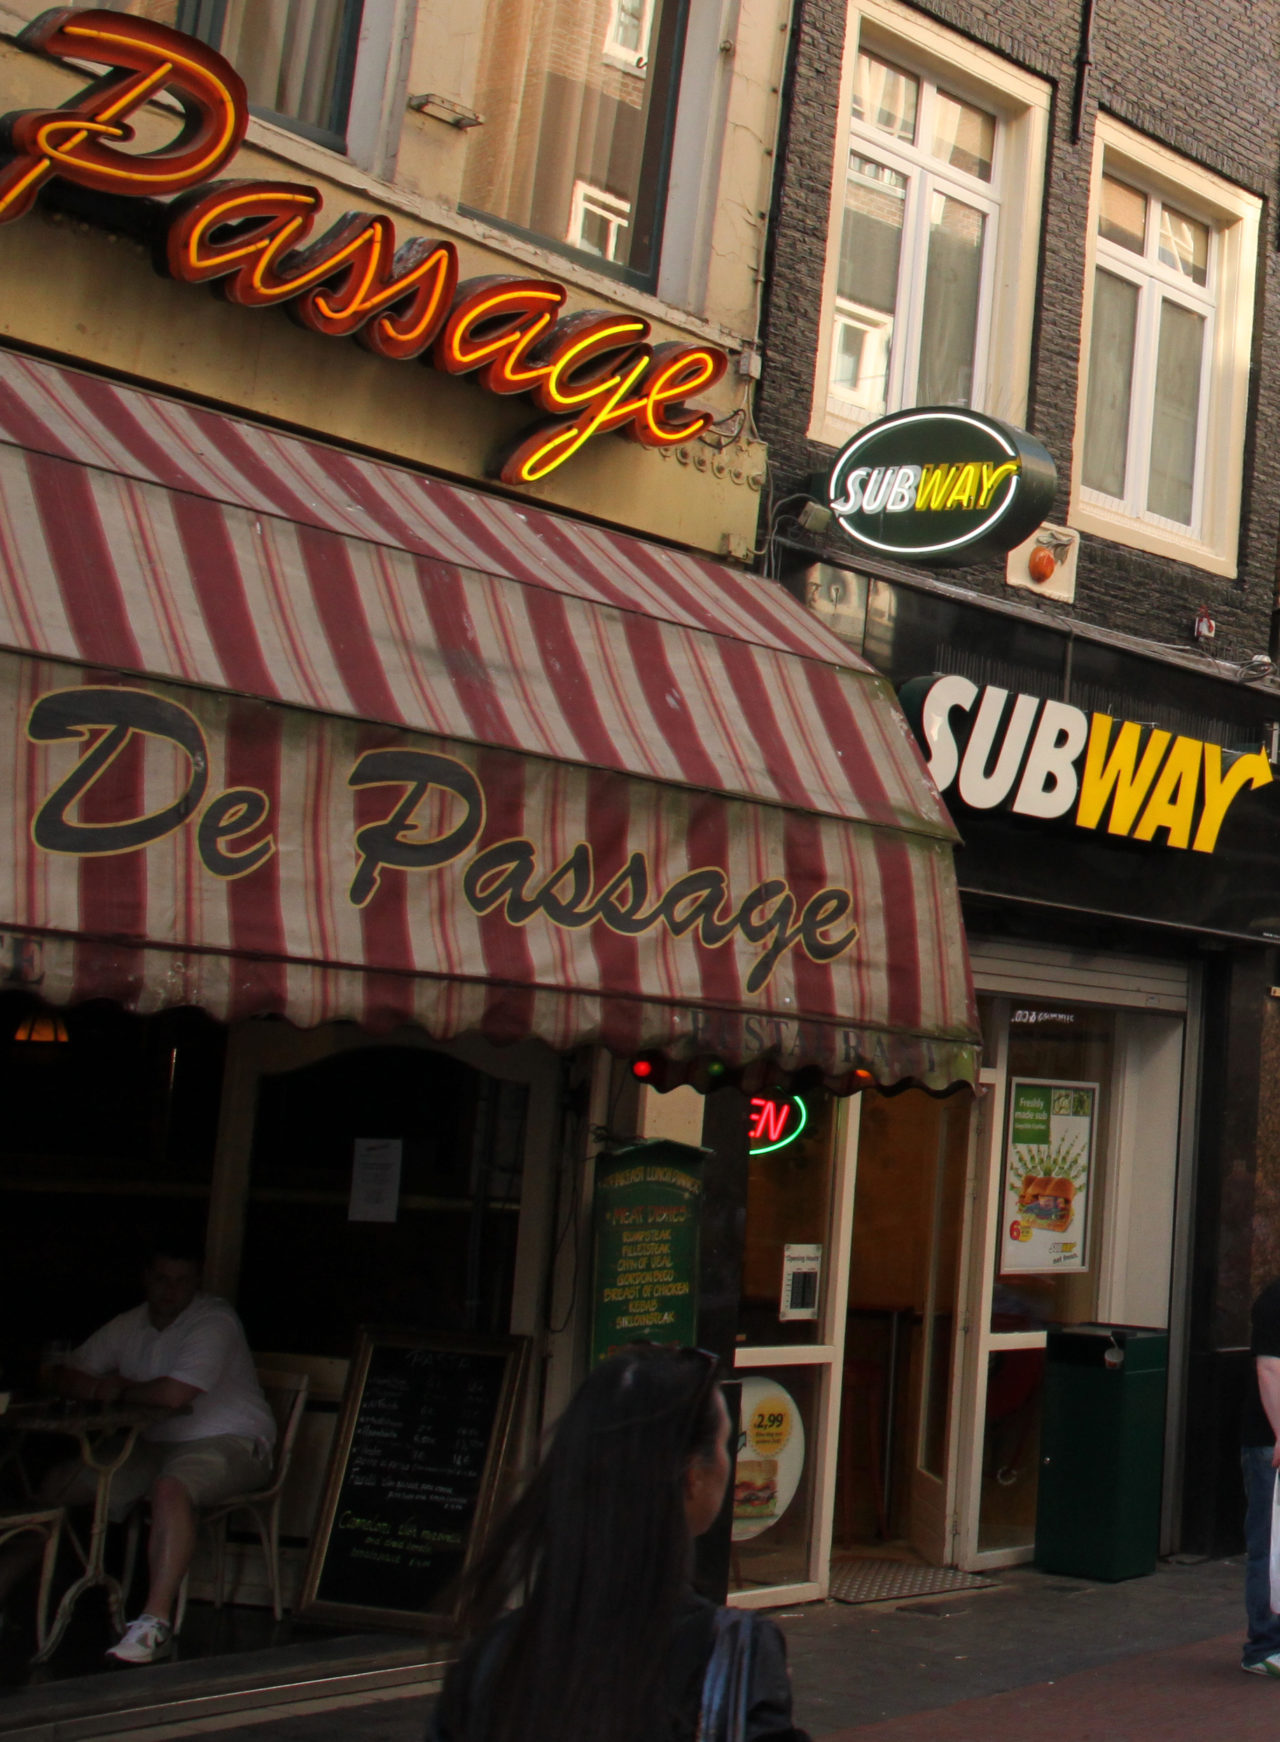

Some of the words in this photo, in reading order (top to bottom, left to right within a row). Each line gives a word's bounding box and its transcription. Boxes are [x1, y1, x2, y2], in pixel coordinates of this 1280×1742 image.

[0, 7, 726, 484] Passage
[831, 460, 1022, 517] SUBWAY
[922, 675, 1274, 854] SUBWAY
[26, 684, 276, 880] De
[346, 746, 859, 994] Passage
[690, 1008, 939, 1074] RESTARAT
[748, 1098, 791, 1142] EN
